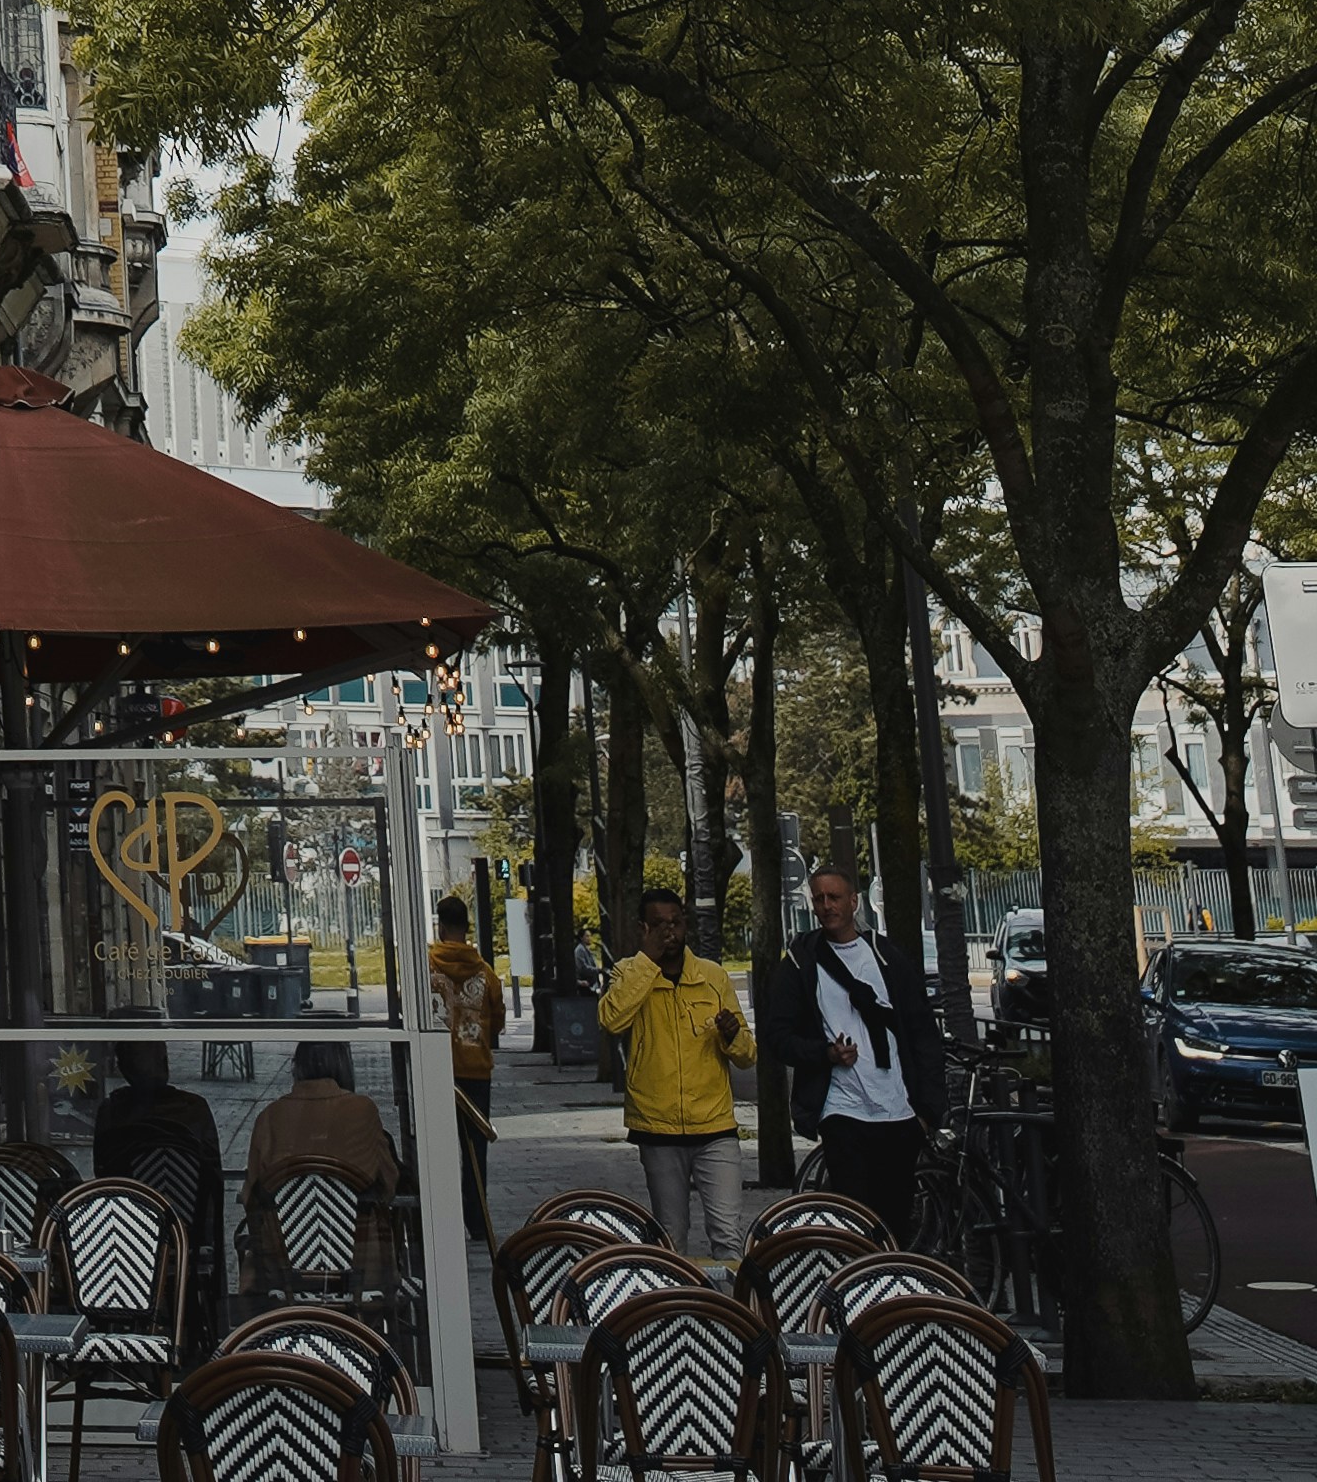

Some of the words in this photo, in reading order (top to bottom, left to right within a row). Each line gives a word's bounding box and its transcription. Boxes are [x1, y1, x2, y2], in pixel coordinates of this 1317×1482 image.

[94, 940, 139, 962] Café
[117, 968, 152, 980] CHEZ
[156, 968, 209, 980] BOUBIER
